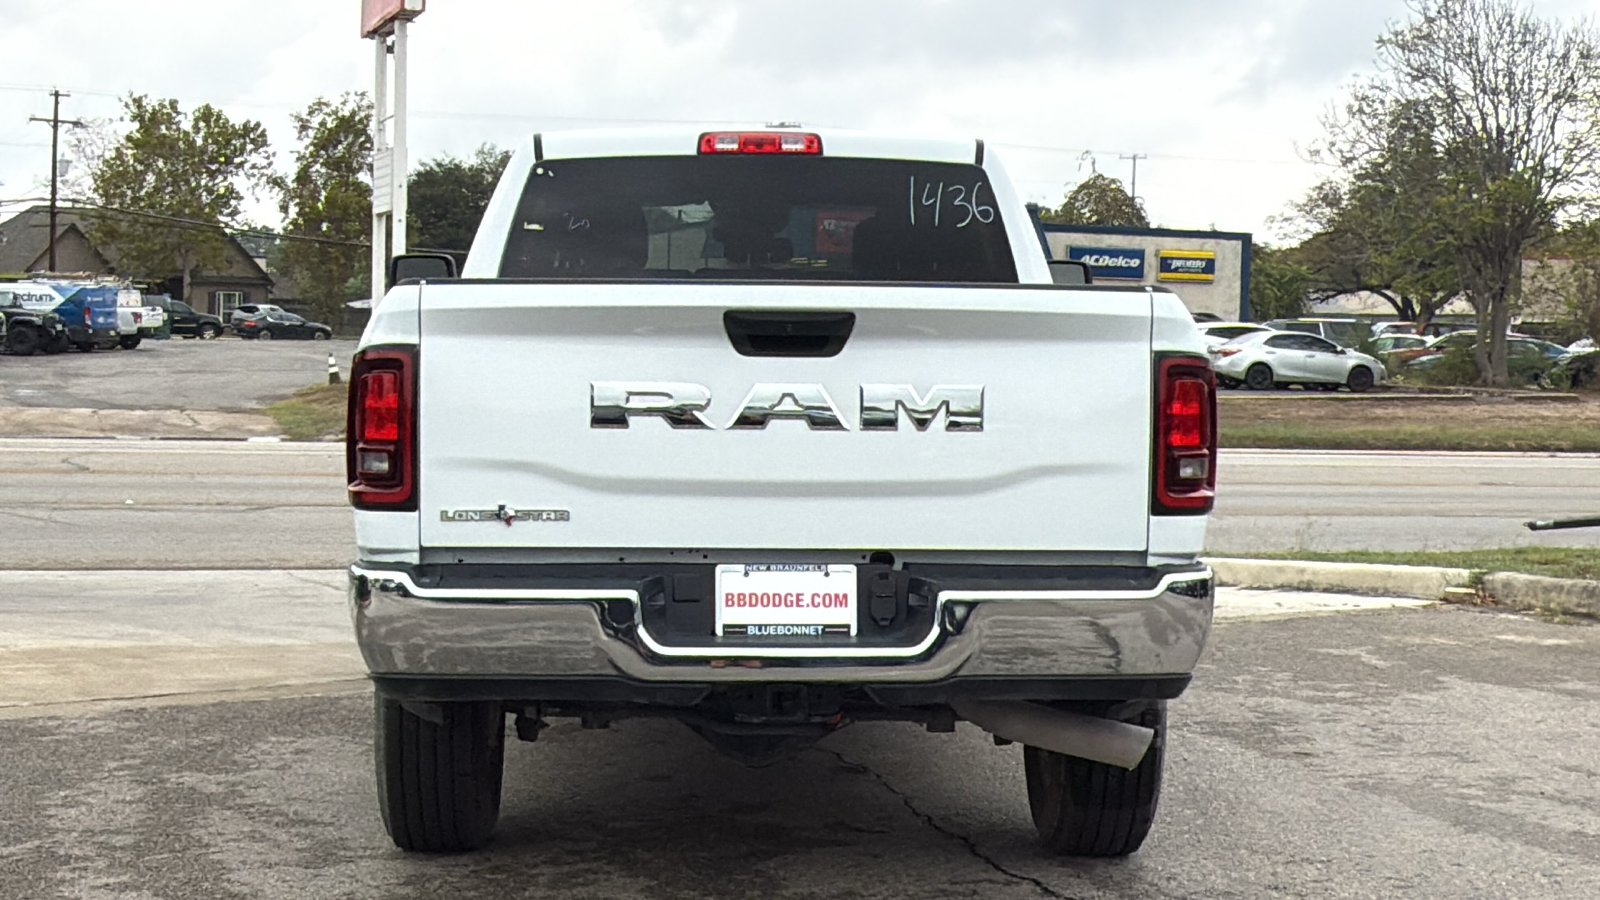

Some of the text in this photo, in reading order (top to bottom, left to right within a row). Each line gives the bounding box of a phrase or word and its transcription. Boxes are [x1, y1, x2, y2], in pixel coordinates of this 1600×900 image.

[910, 176, 994, 227] 1436
[1080, 254, 1141, 268] ACDelco
[591, 381, 985, 432] RAM
[440, 510, 570, 521] LONE STAR
[745, 564, 767, 572] NEW
[725, 592, 848, 609] BBDODGE.COM
[747, 625, 824, 636] BLUEBONNET
